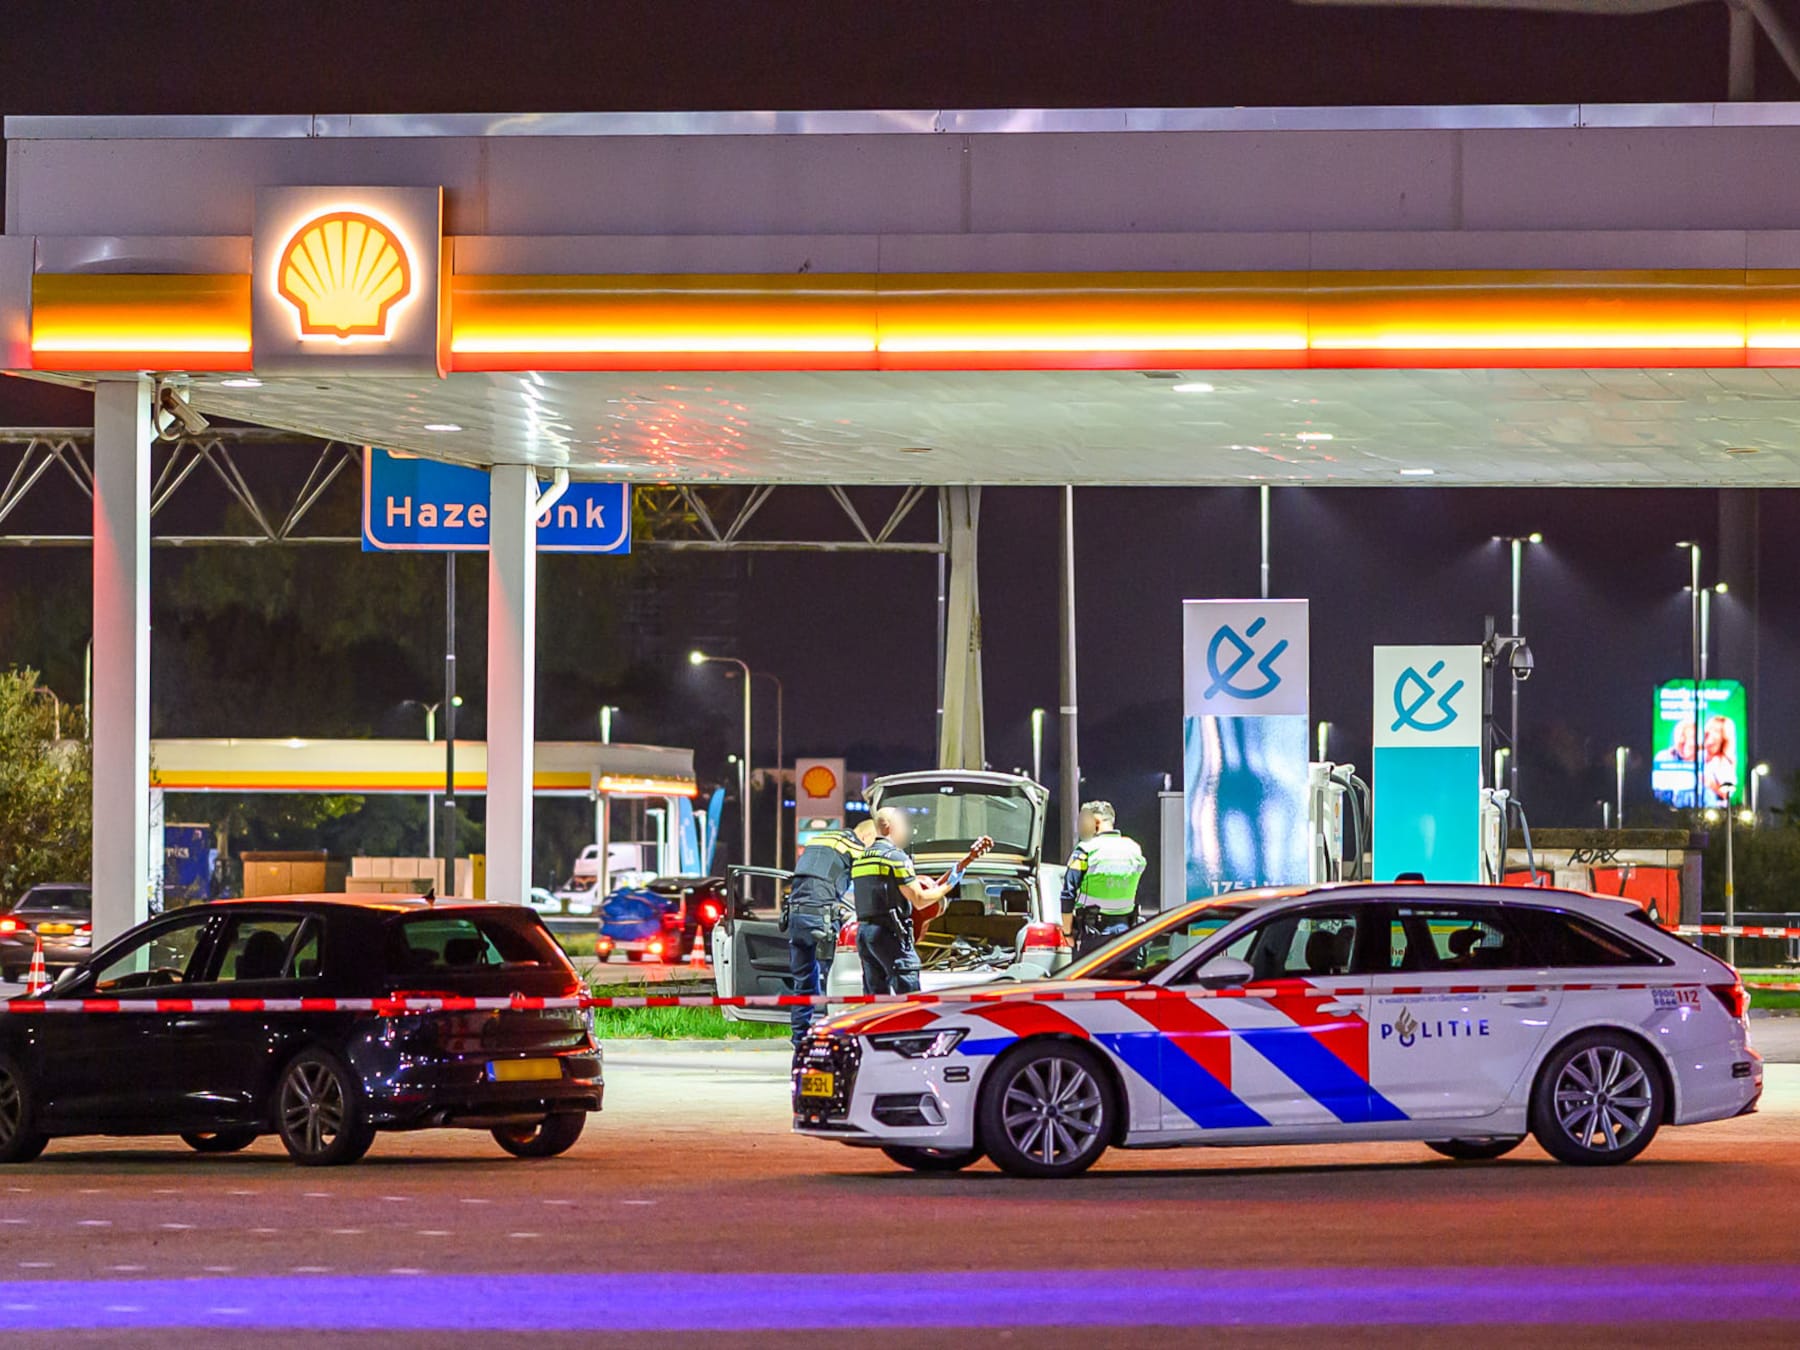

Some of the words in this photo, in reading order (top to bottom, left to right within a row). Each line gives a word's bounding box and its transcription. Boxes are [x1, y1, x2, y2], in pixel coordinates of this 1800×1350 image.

[386, 496, 605, 528] Hazeonk
[1677, 990, 1700, 1003] 112
[1381, 1019, 1490, 1047] POLITIE
